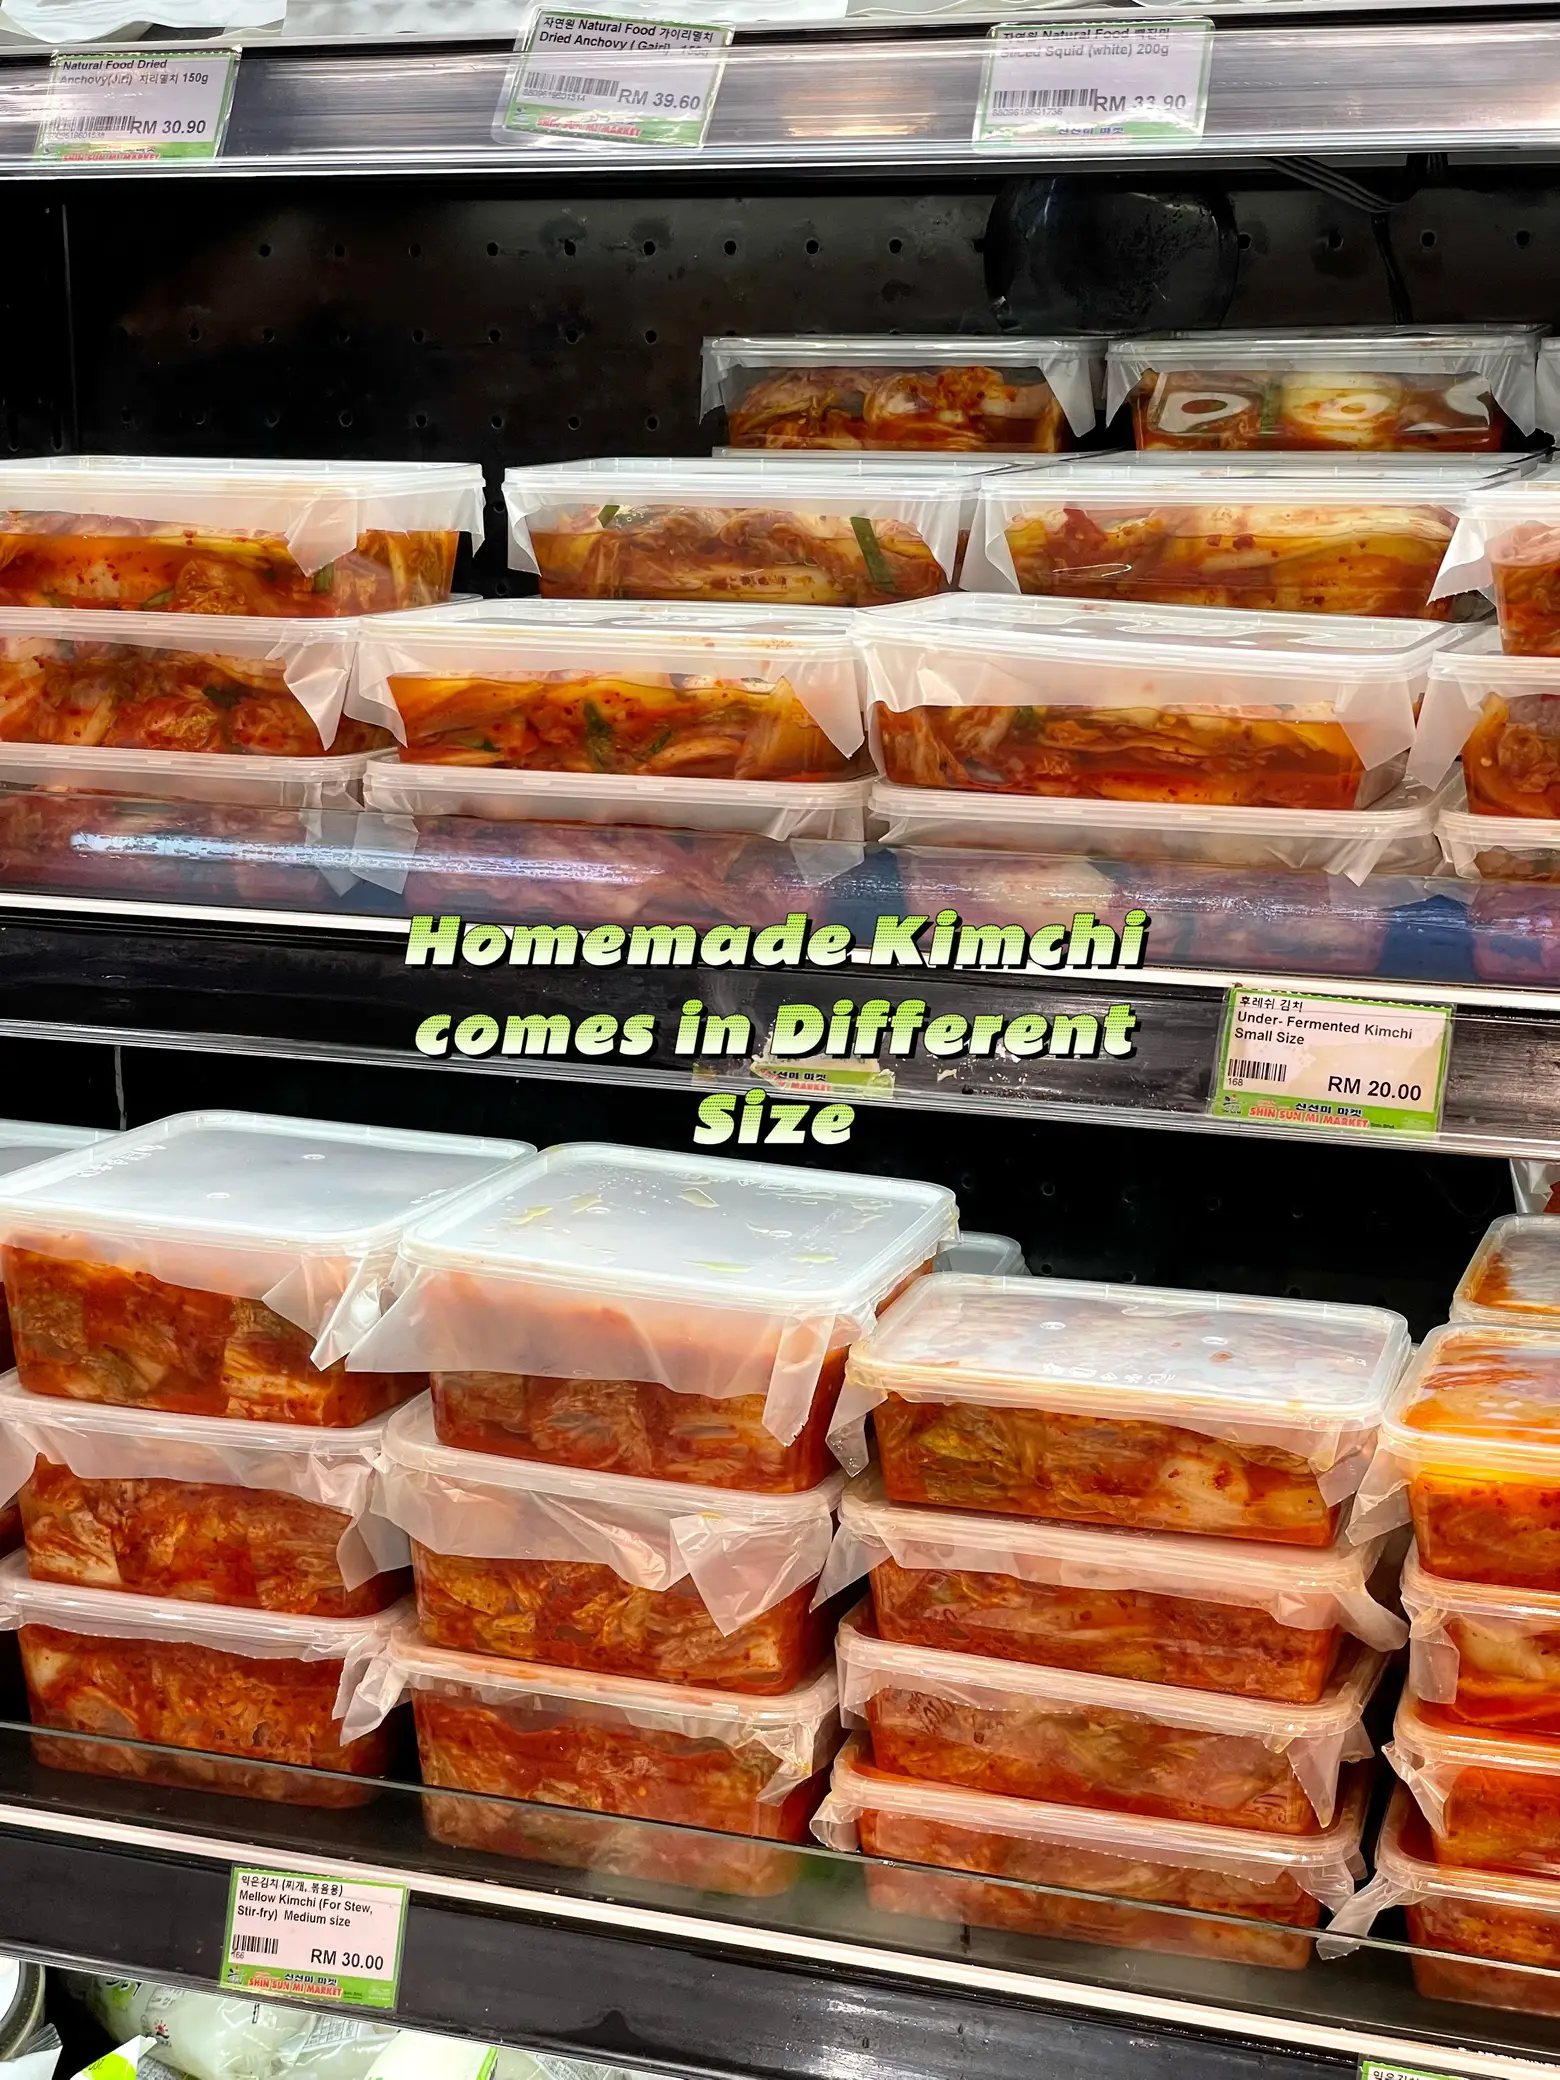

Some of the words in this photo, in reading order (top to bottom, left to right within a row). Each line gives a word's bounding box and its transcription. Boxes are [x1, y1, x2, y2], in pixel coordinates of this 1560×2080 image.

[578, 20, 622, 33] Natural
[625, 23, 657, 36] Food
[1043, 29, 1091, 41] Natural
[1096, 28, 1130, 39] Food
[540, 32, 572, 44] Dried
[574, 35, 628, 51] Anchovy
[1045, 45, 1084, 59] Squid
[1088, 44, 1133, 58] (white)
[1136, 44, 1169, 57] 200g
[63, 60, 102, 71] Natural
[105, 60, 135, 70] Food
[137, 60, 168, 70] Dried
[182, 73, 209, 84] 150g
[618, 89, 648, 106] RM
[652, 92, 701, 111] 39.60
[1094, 96, 1127, 112] RM
[130, 120, 158, 135] RM
[162, 120, 207, 134] 30.90
[1240, 996, 1275, 1010] 후레쉬
[1280, 999, 1303, 1012] 김치
[1237, 1011, 1283, 1025] Under-
[1286, 1016, 1361, 1034] Fermented
[1364, 1024, 1413, 1040] Kimchi
[1234, 1027, 1273, 1042] Small
[1276, 1031, 1305, 1045] Size
[1228, 1077, 1244, 1087] 168
[1328, 1075, 1361, 1095] RM
[1367, 1080, 1422, 1102] 20.00
[1249, 1106, 1276, 1118] SHIN
[1278, 1109, 1302, 1121] SUN
[1304, 1113, 1320, 1123] MI
[1322, 1115, 1369, 1129] MARKET
[1337, 1107, 1363, 1118] 마켓
[241, 1875, 279, 1889] 익은김치
[239, 1890, 276, 1903] Mellow
[279, 1894, 317, 1908] Kimchi
[319, 1898, 342, 1911] (For
[344, 1901, 373, 1915] Stew,
[237, 1905, 278, 1921] Stir-fry)
[284, 1910, 327, 1925] Medium
[329, 1916, 351, 1927] size
[231, 1951, 245, 1960] 166
[310, 1948, 337, 1965] RM
[341, 1952, 384, 1971] 30.00
[248, 1978, 270, 1989] SHIN
[271, 1981, 290, 1991] SUN
[292, 1983, 305, 1994] MI
[305, 1985, 343, 1998] MARKET
